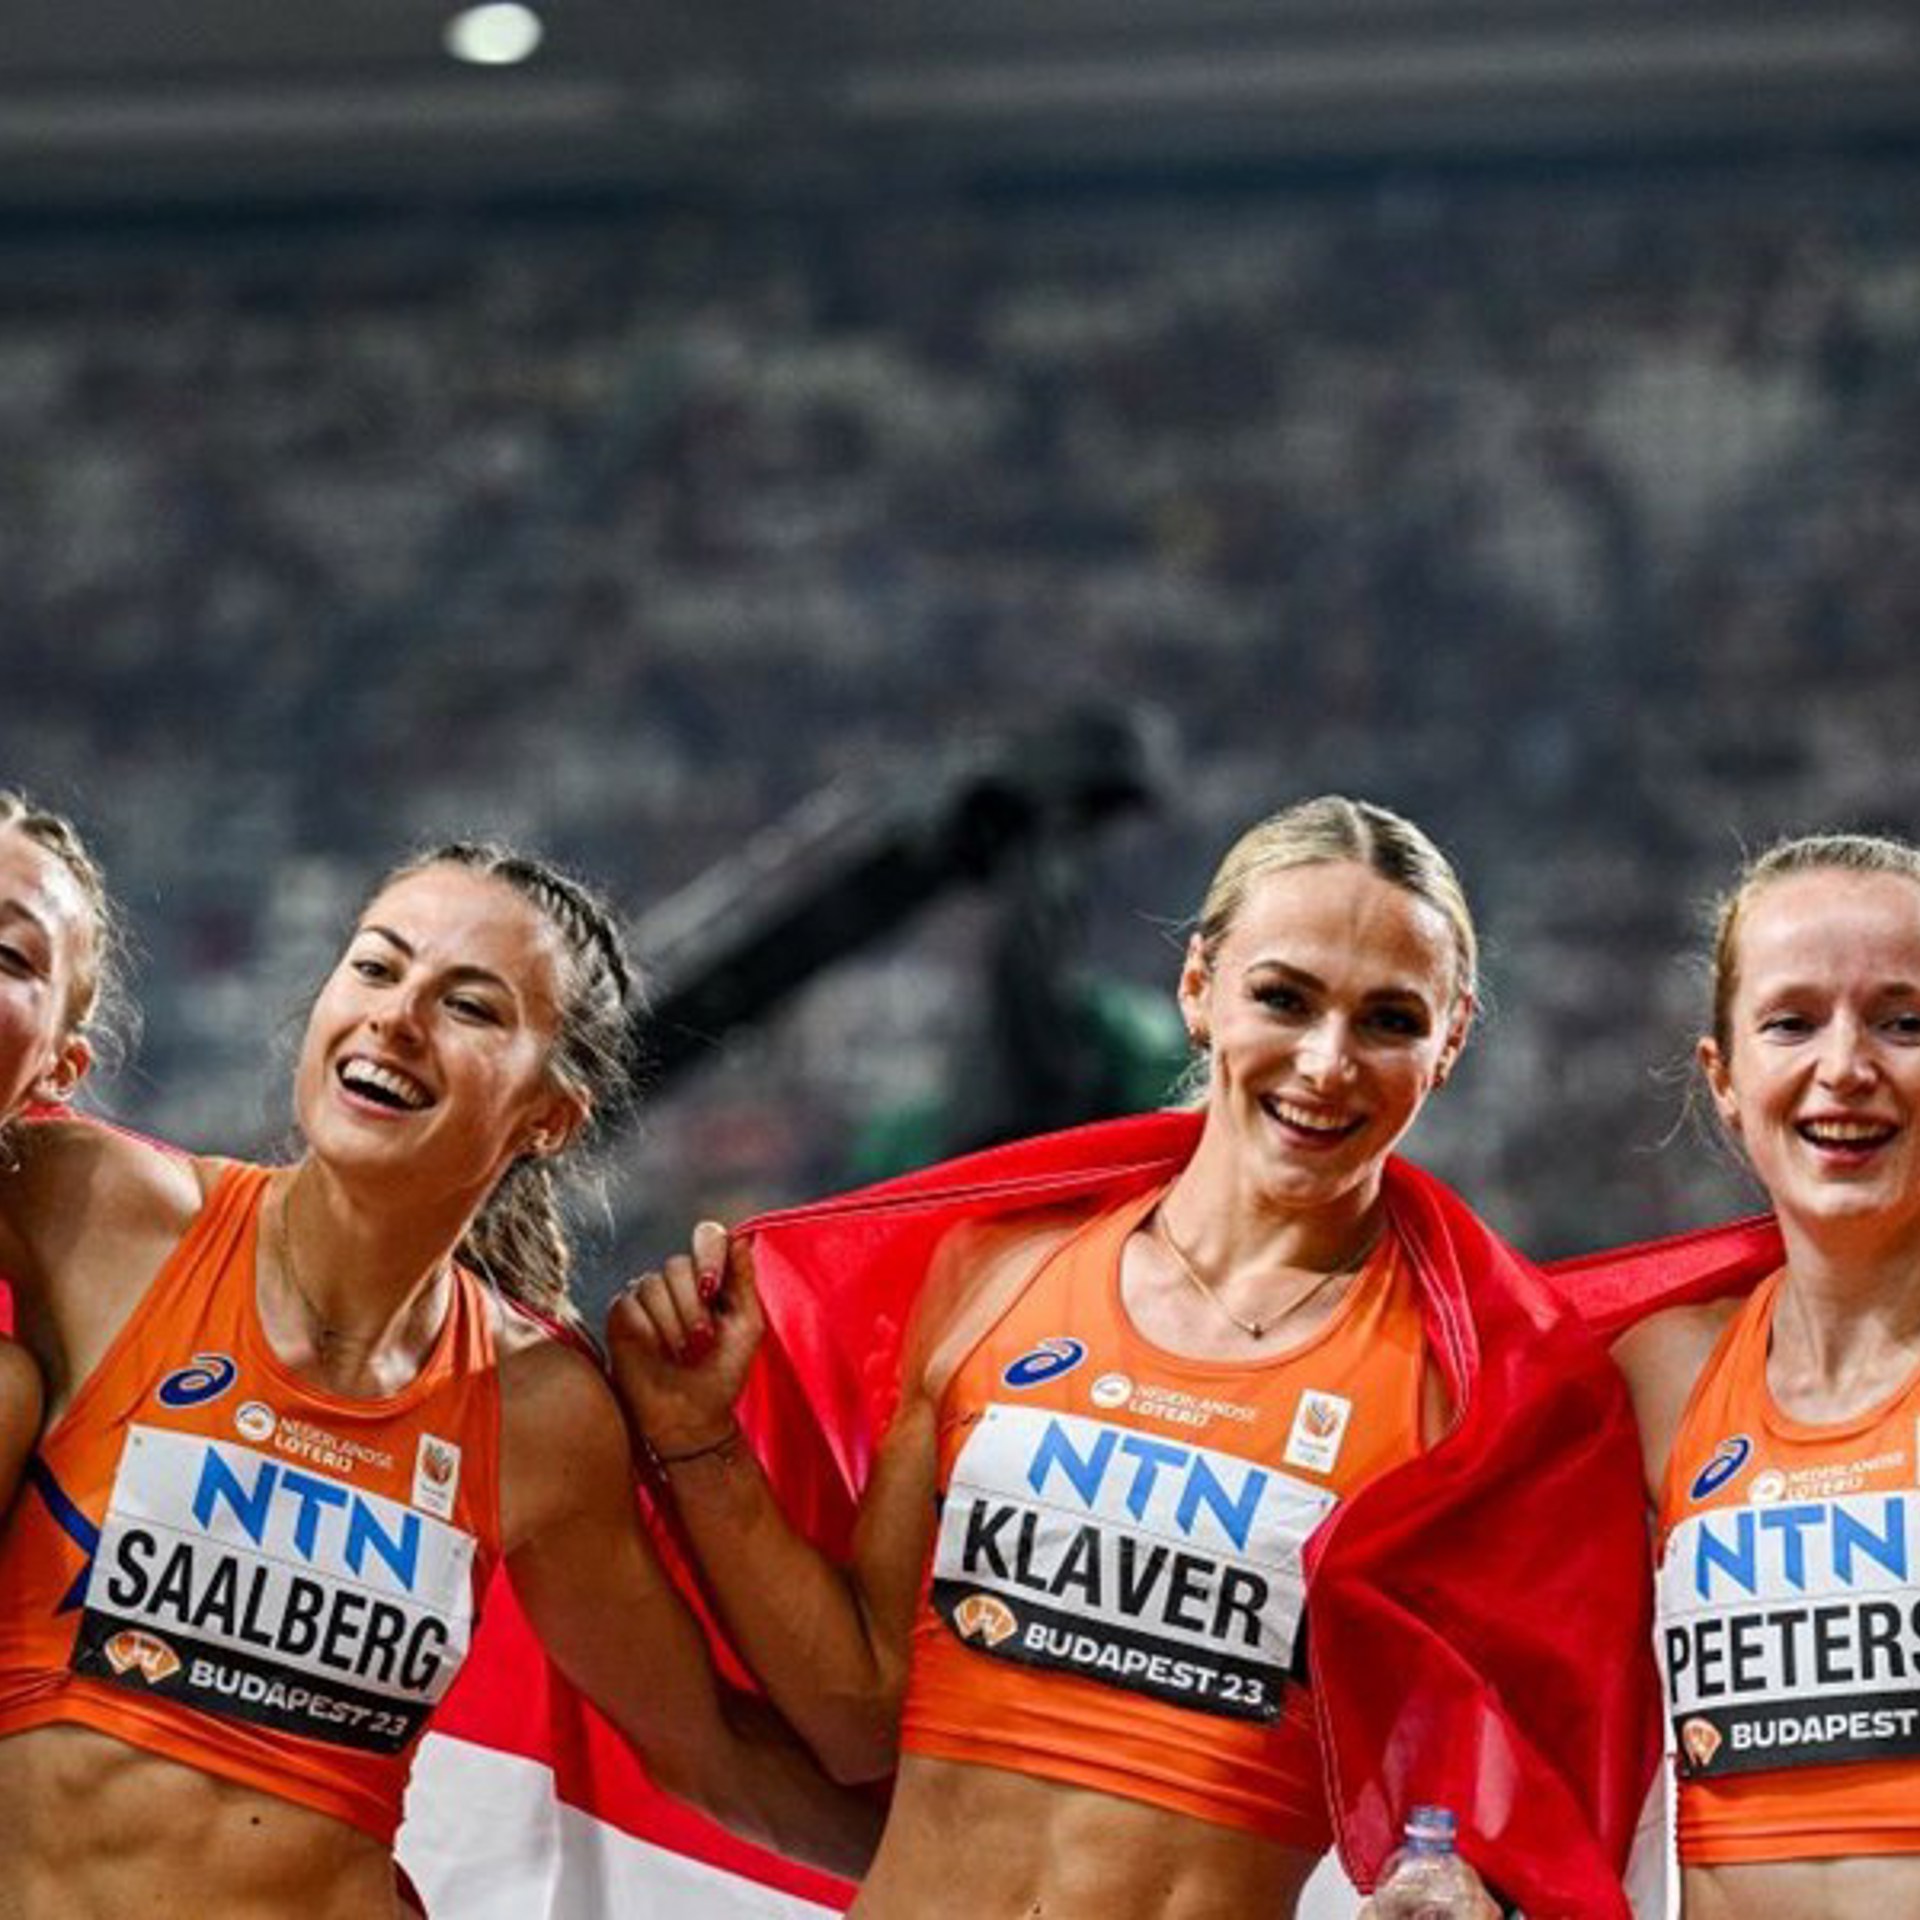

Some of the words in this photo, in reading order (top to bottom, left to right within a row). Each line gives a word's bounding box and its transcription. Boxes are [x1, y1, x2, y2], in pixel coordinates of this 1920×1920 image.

[192, 1446, 422, 1593] NTN
[1027, 1418, 1269, 1554] NTN
[961, 1499, 1270, 1649] KLAVER
[1695, 1496, 1908, 1601] NTN
[107, 1529, 447, 1695] SAALBERG
[1023, 1621, 1218, 1694] BUDAPEST
[1219, 1673, 1265, 1704] 23
[188, 1658, 371, 1727] BUDAPEST
[368, 1710, 410, 1737] 23
[1730, 1708, 1919, 1751] BUDAPEST
